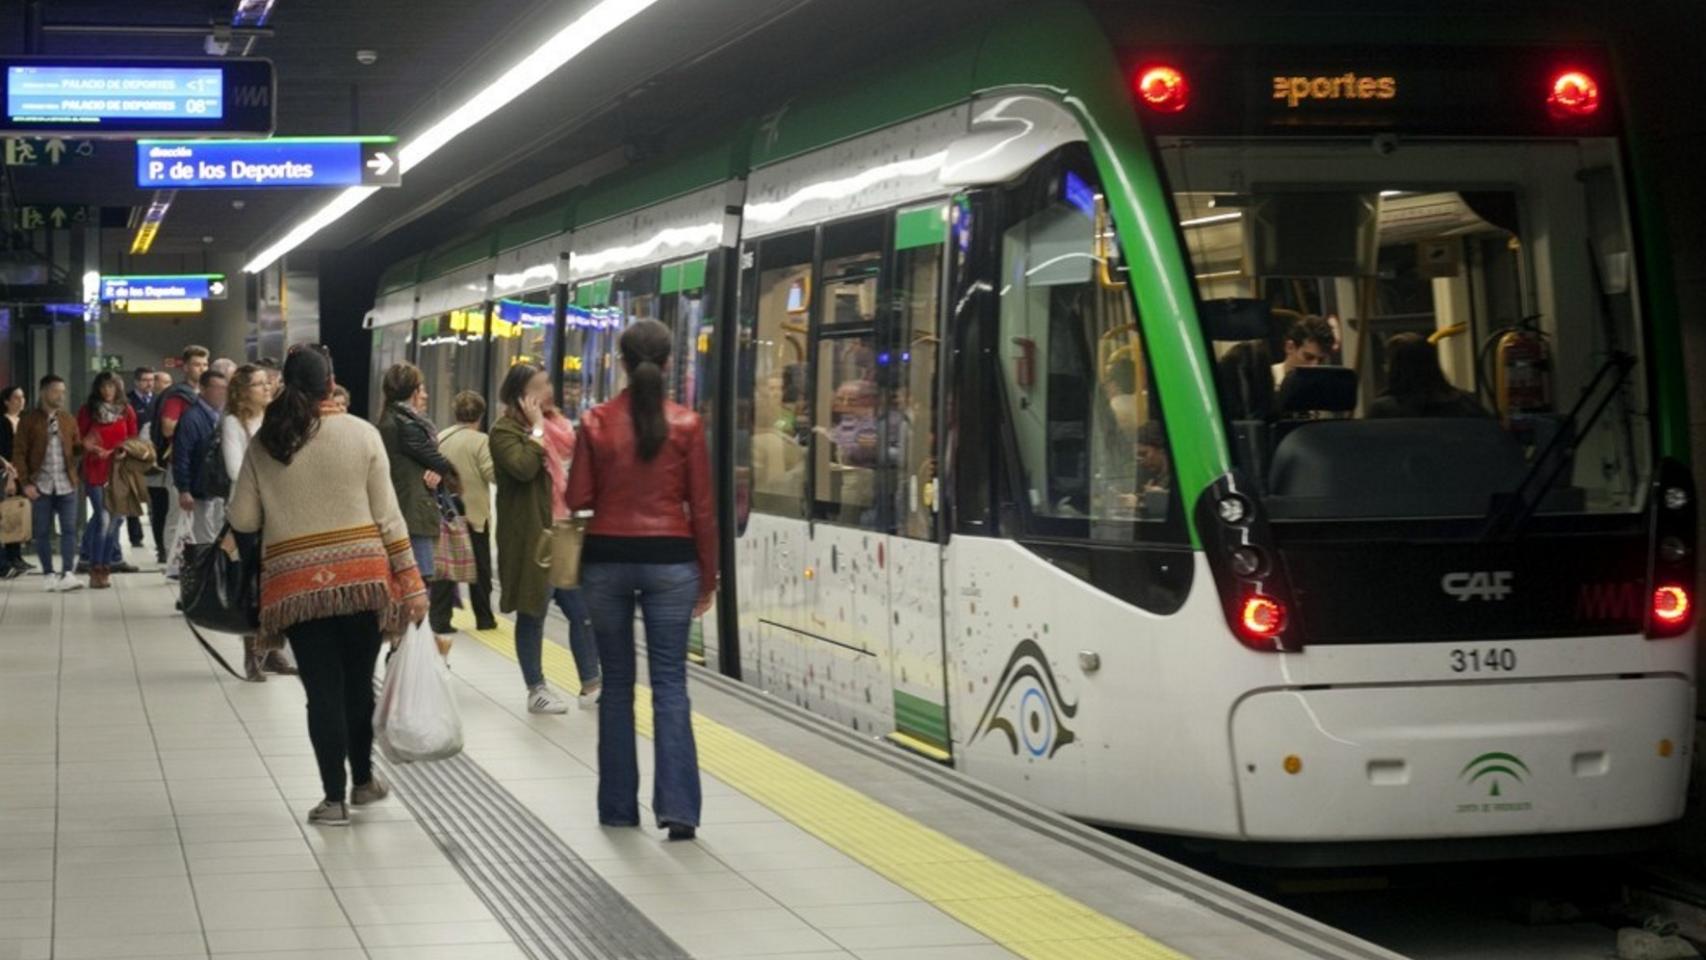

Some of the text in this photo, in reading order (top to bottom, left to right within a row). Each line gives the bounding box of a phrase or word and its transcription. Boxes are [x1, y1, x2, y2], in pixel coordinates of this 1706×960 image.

[61, 79, 105, 90] PALACIO
[106, 79, 120, 90] DE
[122, 79, 176, 90] DEPORTES
[61, 99, 105, 111] PALACIO
[106, 99, 120, 111] DE
[122, 99, 176, 111] DEPORTES
[149, 160, 313, 183] P. de los Deportes
[115, 286, 128, 297] de
[129, 286, 144, 297] los
[145, 286, 186, 298] Deportes
[1441, 571, 1514, 601] CAF
[1450, 648, 1516, 673] 3140
